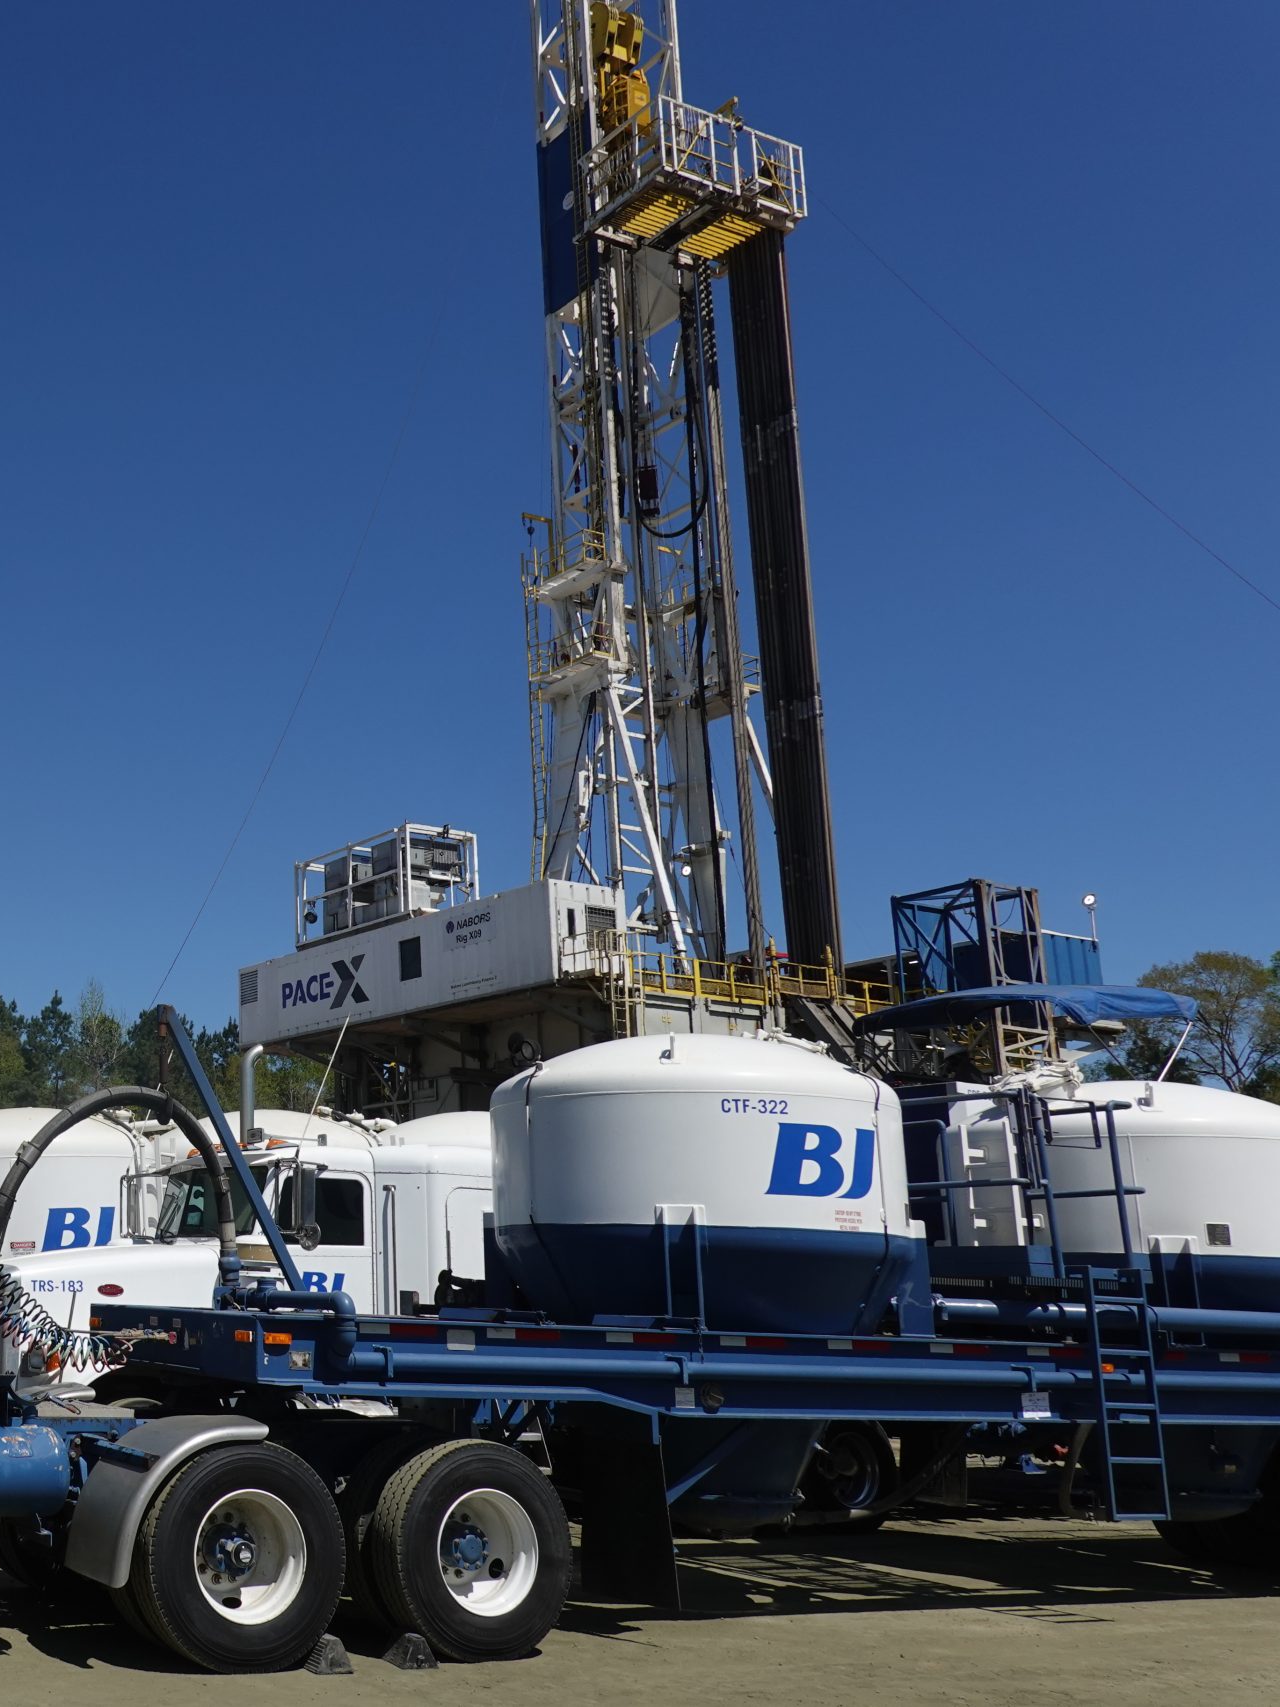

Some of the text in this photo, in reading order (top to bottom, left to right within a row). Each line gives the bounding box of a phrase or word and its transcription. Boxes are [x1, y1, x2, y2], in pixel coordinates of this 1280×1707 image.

[456, 912, 491, 930] NABORS
[456, 933, 468, 944] Rig
[721, 1099, 789, 1115] CTF-322
[764, 1122, 876, 1200] BJ
[31, 1280, 84, 1293] TRS-183
